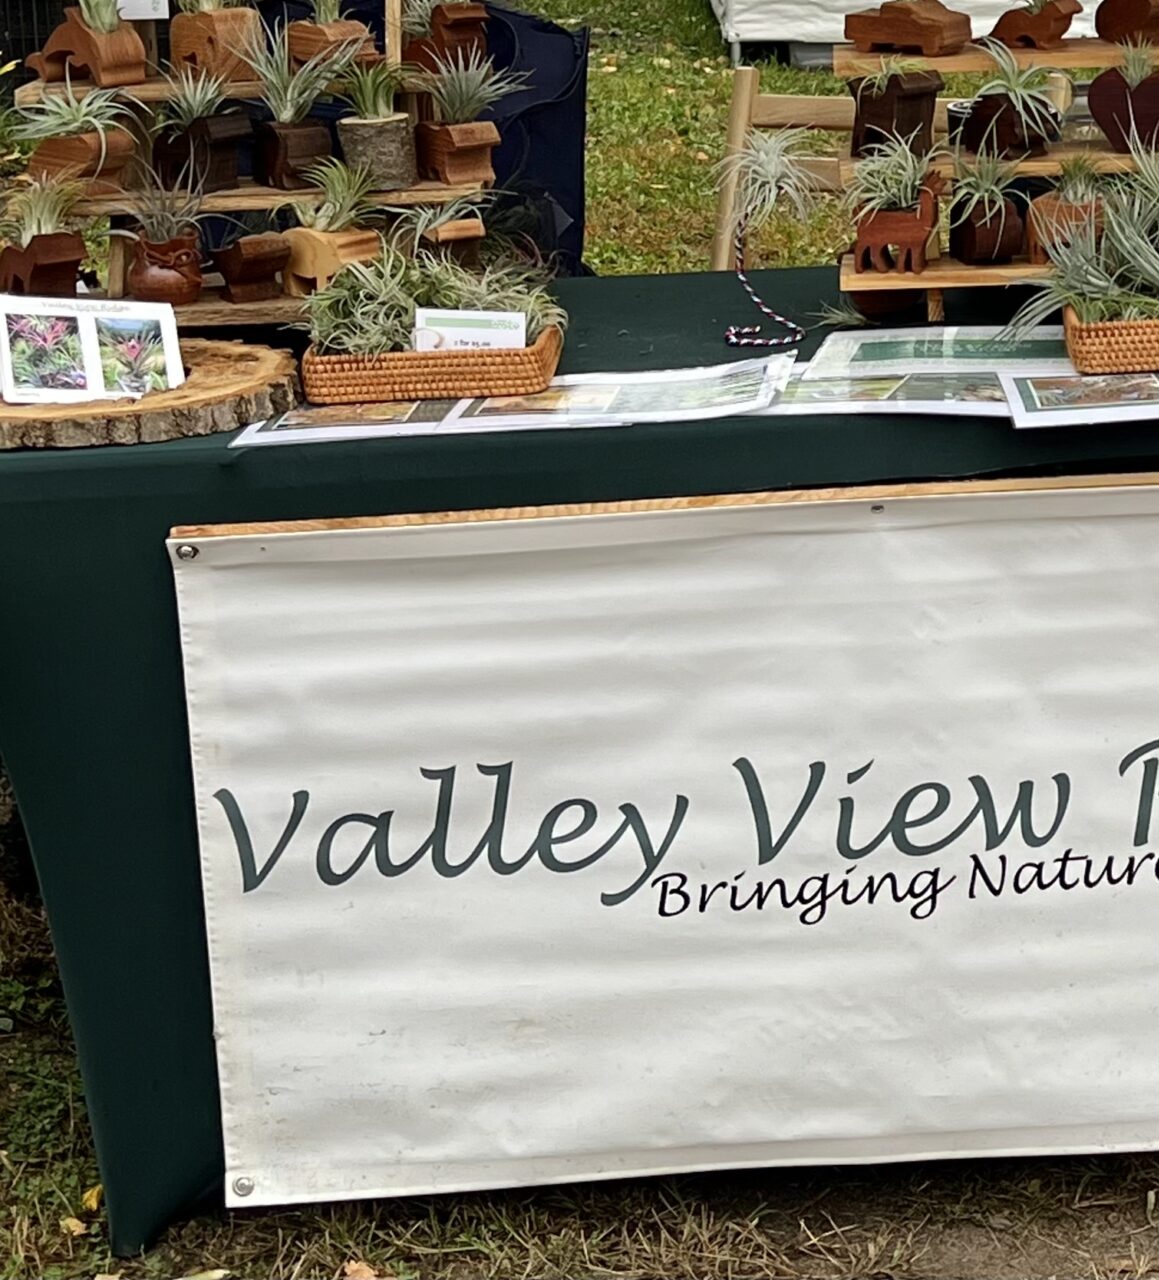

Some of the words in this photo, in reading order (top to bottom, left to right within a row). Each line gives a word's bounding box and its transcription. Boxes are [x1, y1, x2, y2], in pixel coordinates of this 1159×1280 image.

[212, 760, 689, 907] Valley
[731, 756, 1071, 866] View
[651, 863, 957, 926] Bringing
